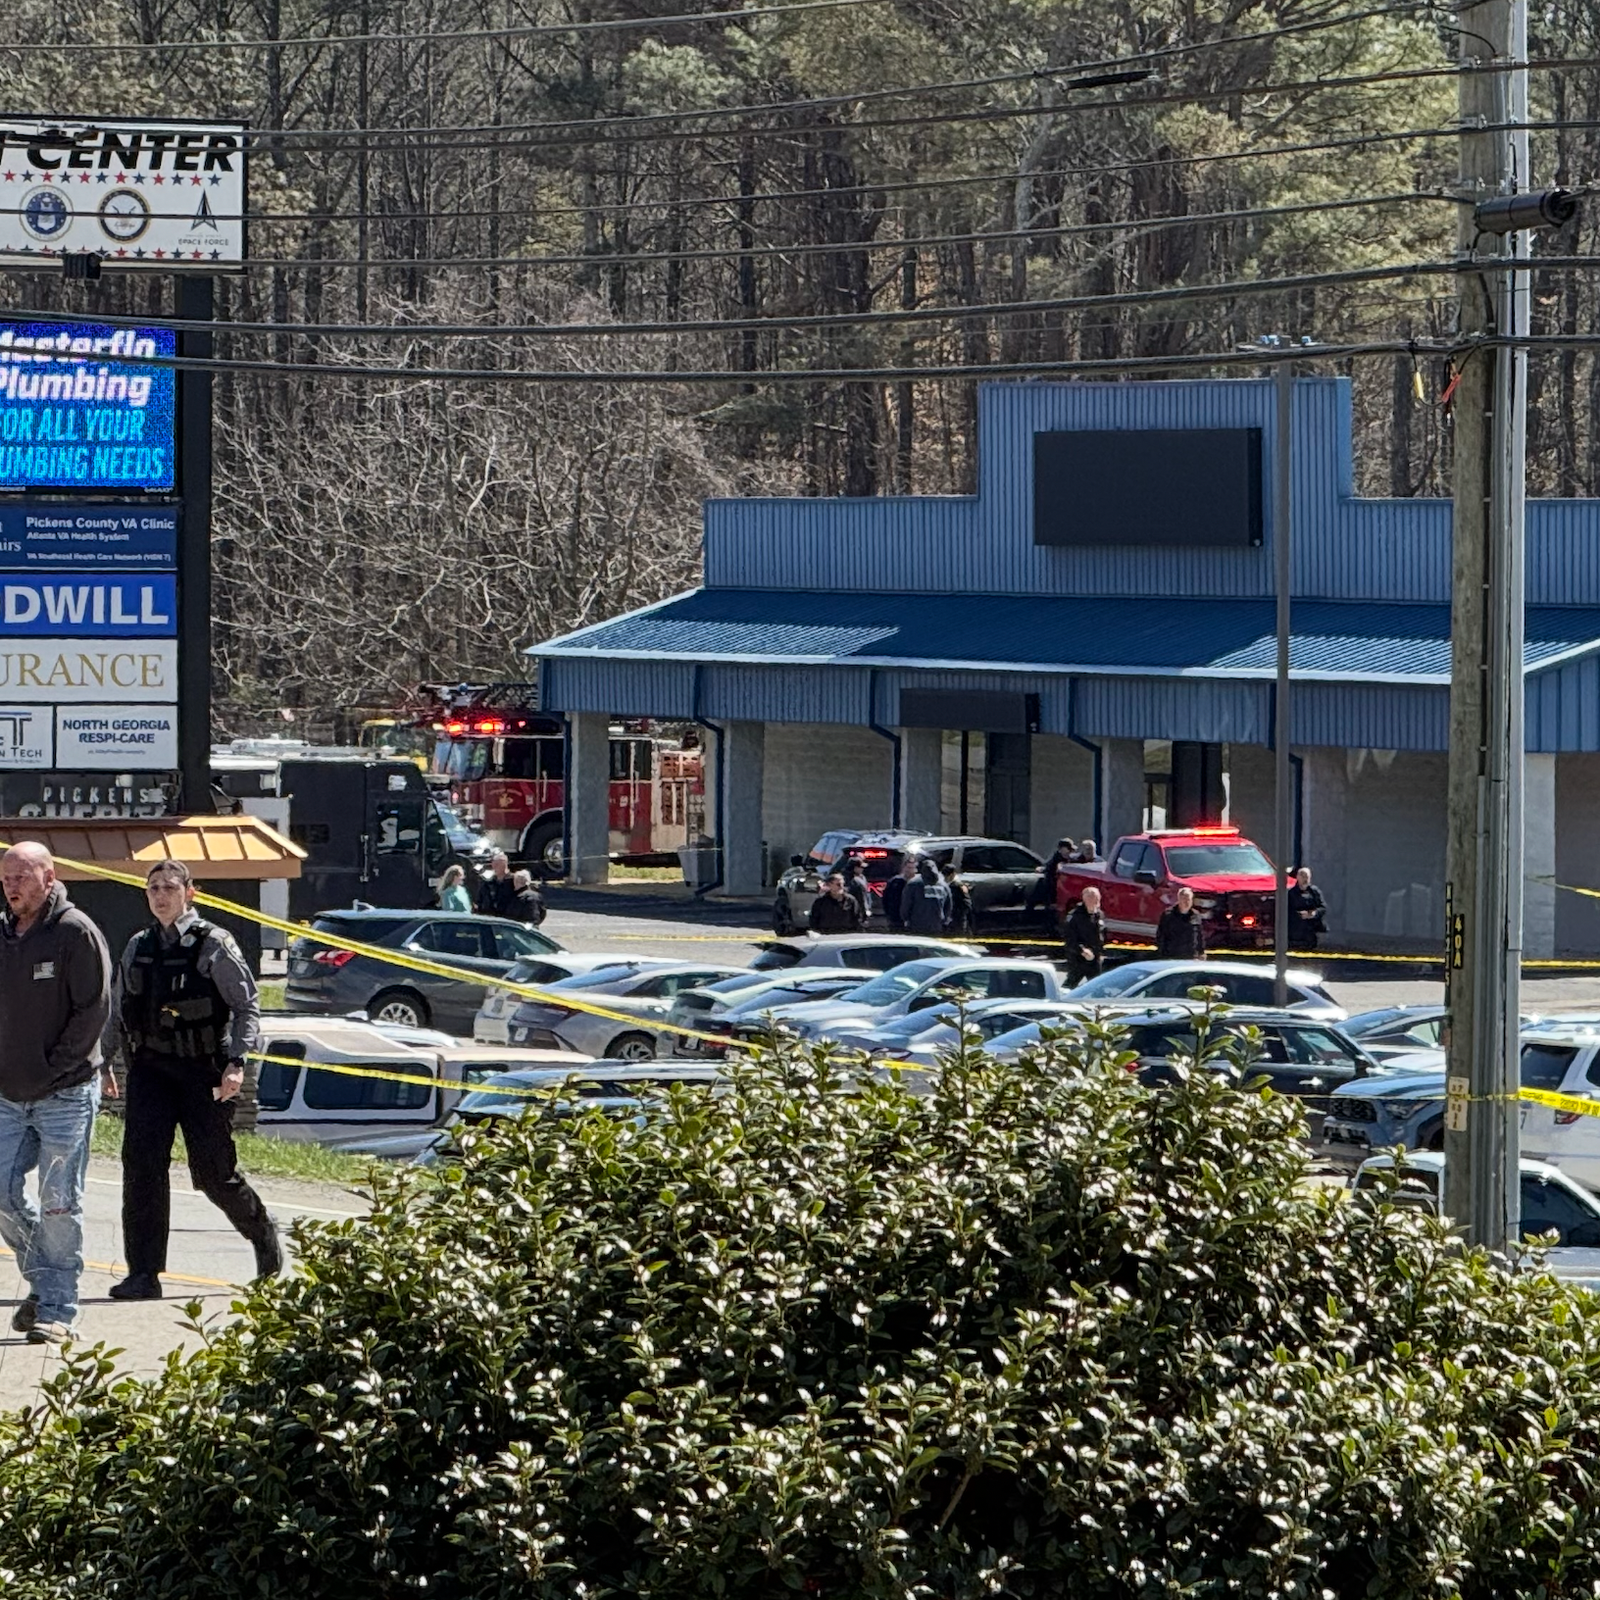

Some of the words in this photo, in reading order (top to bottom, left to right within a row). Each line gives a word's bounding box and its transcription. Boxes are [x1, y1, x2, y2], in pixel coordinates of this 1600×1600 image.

[27, 130, 237, 172] CENTER
[0, 408, 34, 441] OR
[37, 408, 79, 441] ALL
[86, 408, 146, 441] YOUR
[93, 446, 165, 480] NEEDS
[26, 516, 73, 528] Pickens
[75, 517, 119, 530] County
[121, 518, 138, 529] VA
[140, 518, 175, 530] Clinic
[57, 532, 69, 540] VA
[71, 532, 97, 541] Health
[98, 533, 130, 542] System
[4, 585, 169, 625] DWILL
[62, 719, 109, 731] NORTH
[112, 719, 171, 731] GEORGIA
[79, 732, 155, 744] RESPI-CARE
[43, 786, 149, 804] PICKENS
